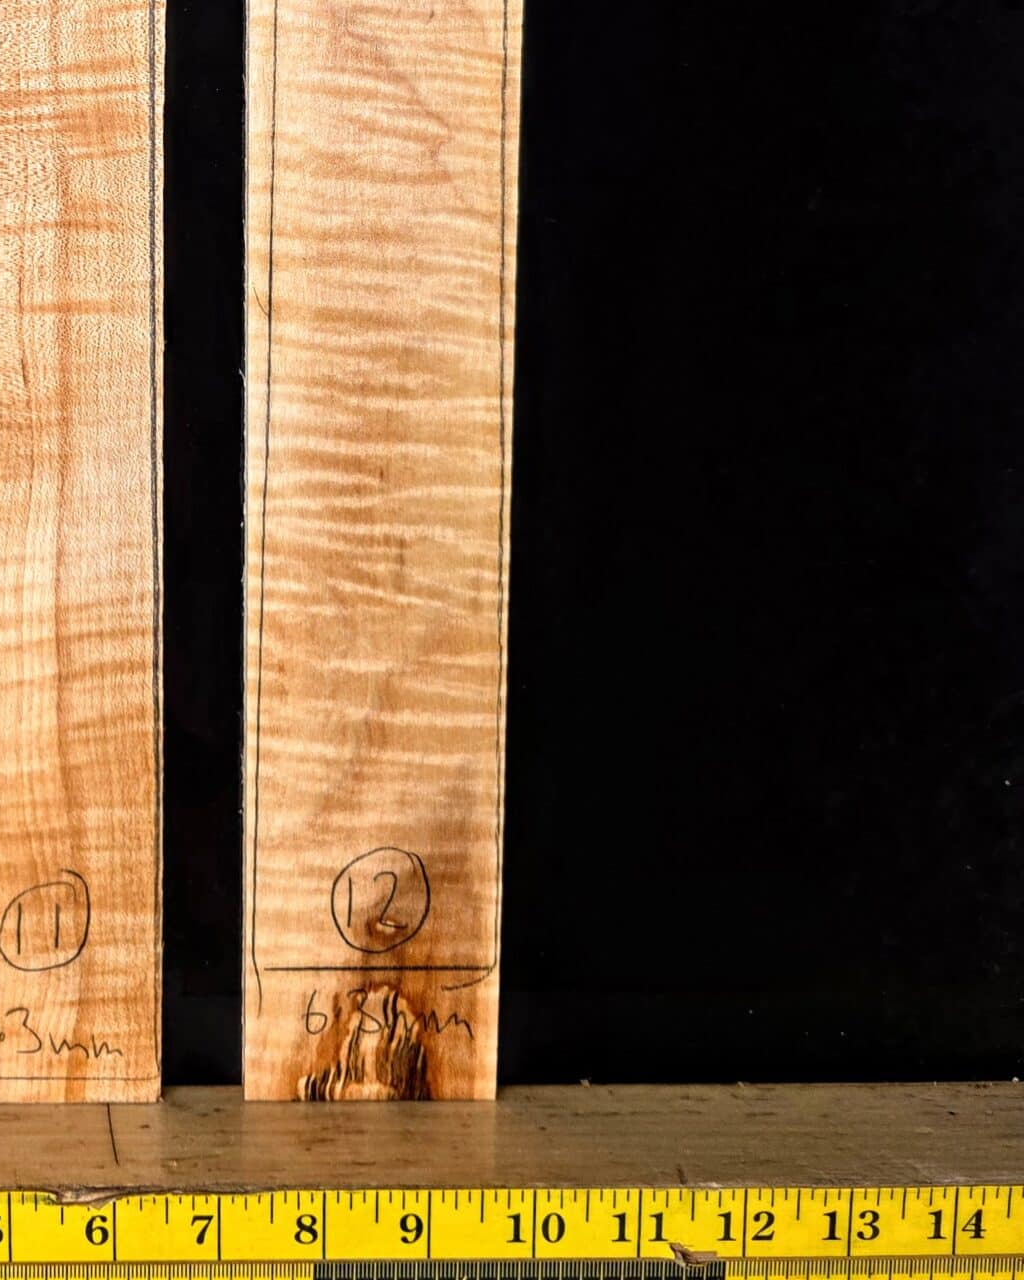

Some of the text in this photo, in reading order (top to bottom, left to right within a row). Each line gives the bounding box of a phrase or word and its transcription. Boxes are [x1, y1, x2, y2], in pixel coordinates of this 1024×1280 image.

[347, 870, 407, 929] 12
[16, 902, 61, 955] 11
[85, 1215, 109, 1245] 6
[191, 1215, 214, 1245] 7
[294, 1214, 318, 1245] 8
[399, 1213, 424, 1244] 9
[507, 1213, 566, 1244] 10
[612, 1212, 668, 1243] 11
[718, 1211, 776, 1242] 12
[822, 1210, 880, 1241] 13
[928, 1208, 987, 1239] 14
